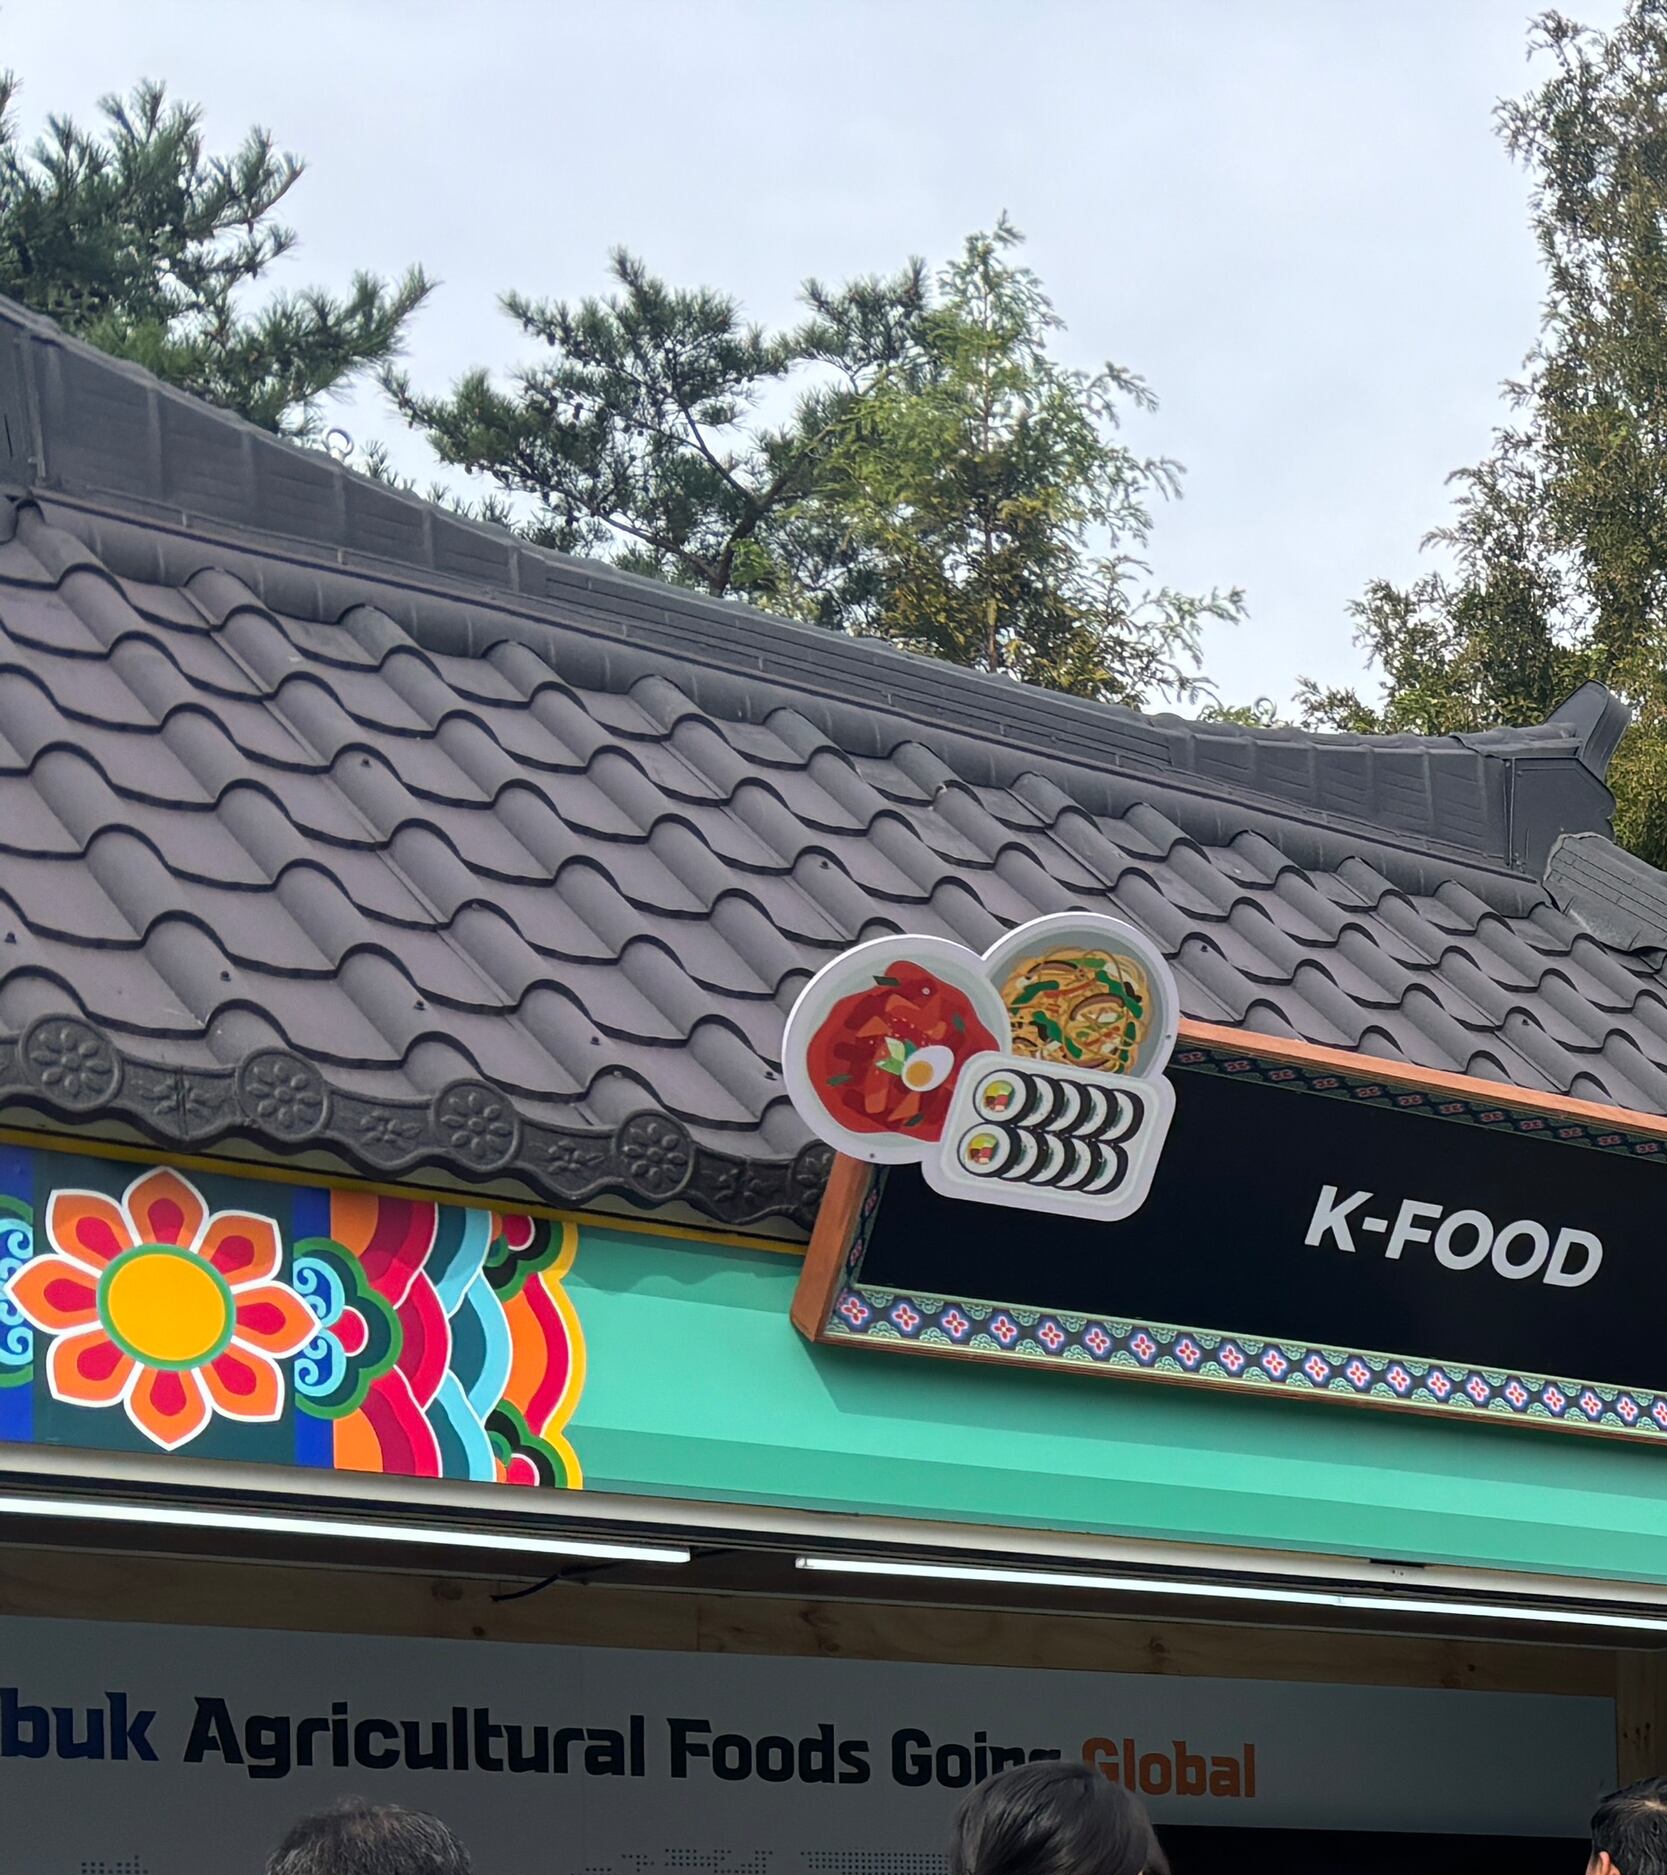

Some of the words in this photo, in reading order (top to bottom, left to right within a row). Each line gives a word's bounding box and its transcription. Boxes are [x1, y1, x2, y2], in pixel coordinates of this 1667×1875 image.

[1304, 1184, 1604, 1288] K-FOOD
[0, 1687, 160, 1761] buk
[183, 1696, 646, 1779] Agricultural
[666, 1717, 871, 1784] Foods
[891, 1708, 1061, 1788] Goin
[1081, 1736, 1256, 1798] Global
